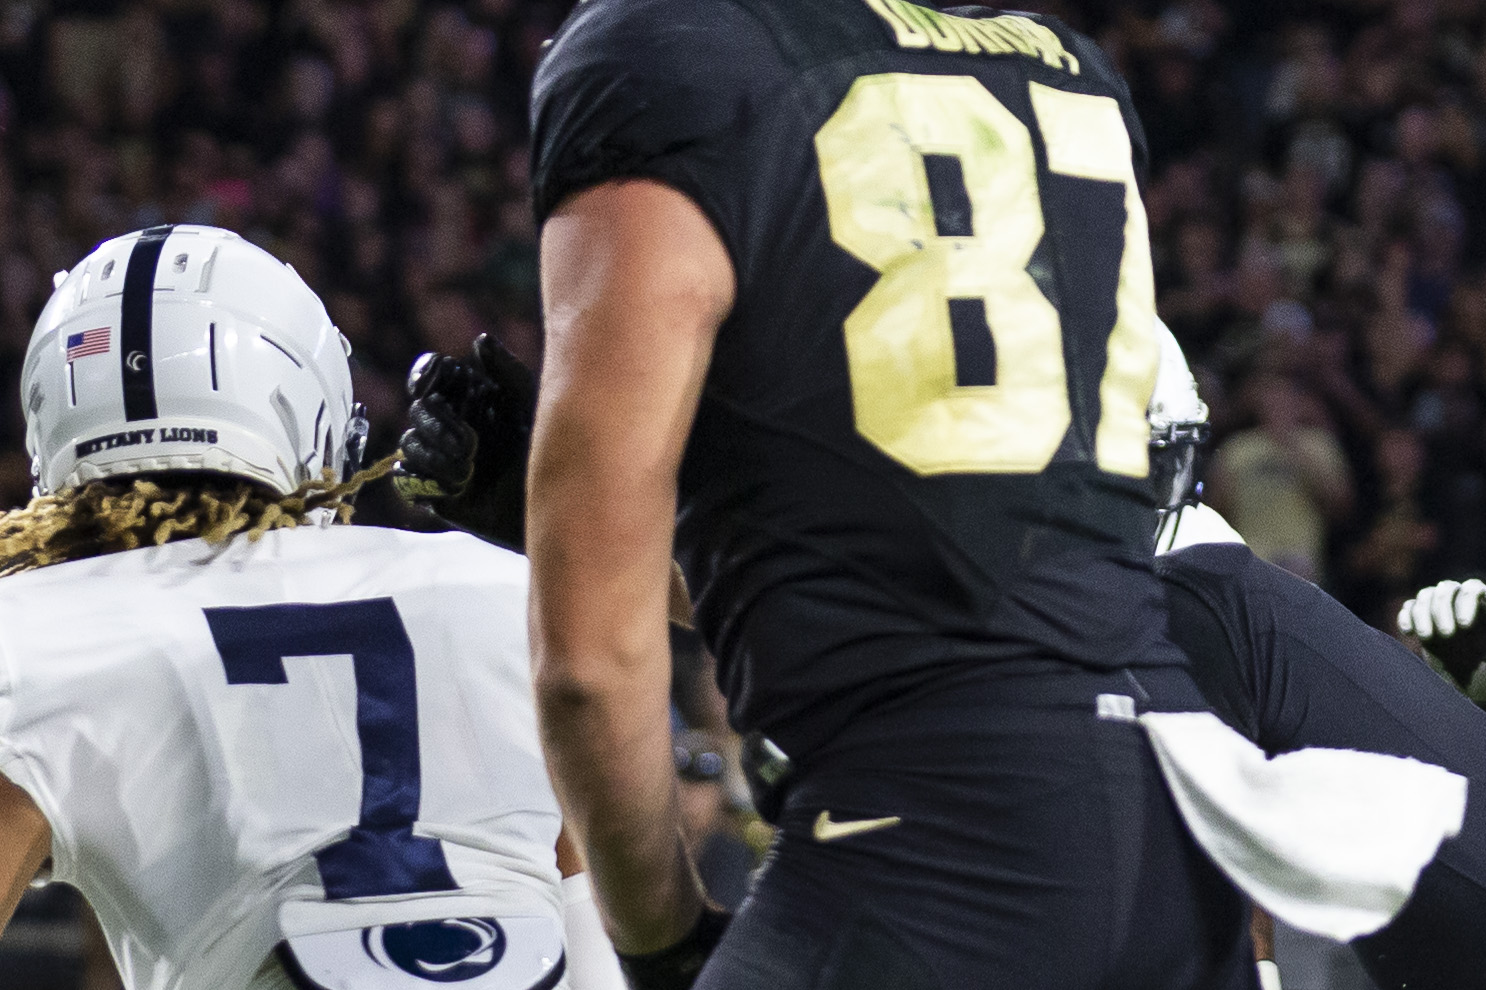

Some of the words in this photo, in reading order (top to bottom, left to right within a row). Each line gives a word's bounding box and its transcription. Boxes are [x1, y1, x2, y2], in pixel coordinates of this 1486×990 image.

[814, 72, 1160, 479] 87
[160, 427, 218, 444] LIONS
[201, 596, 464, 900] 7
